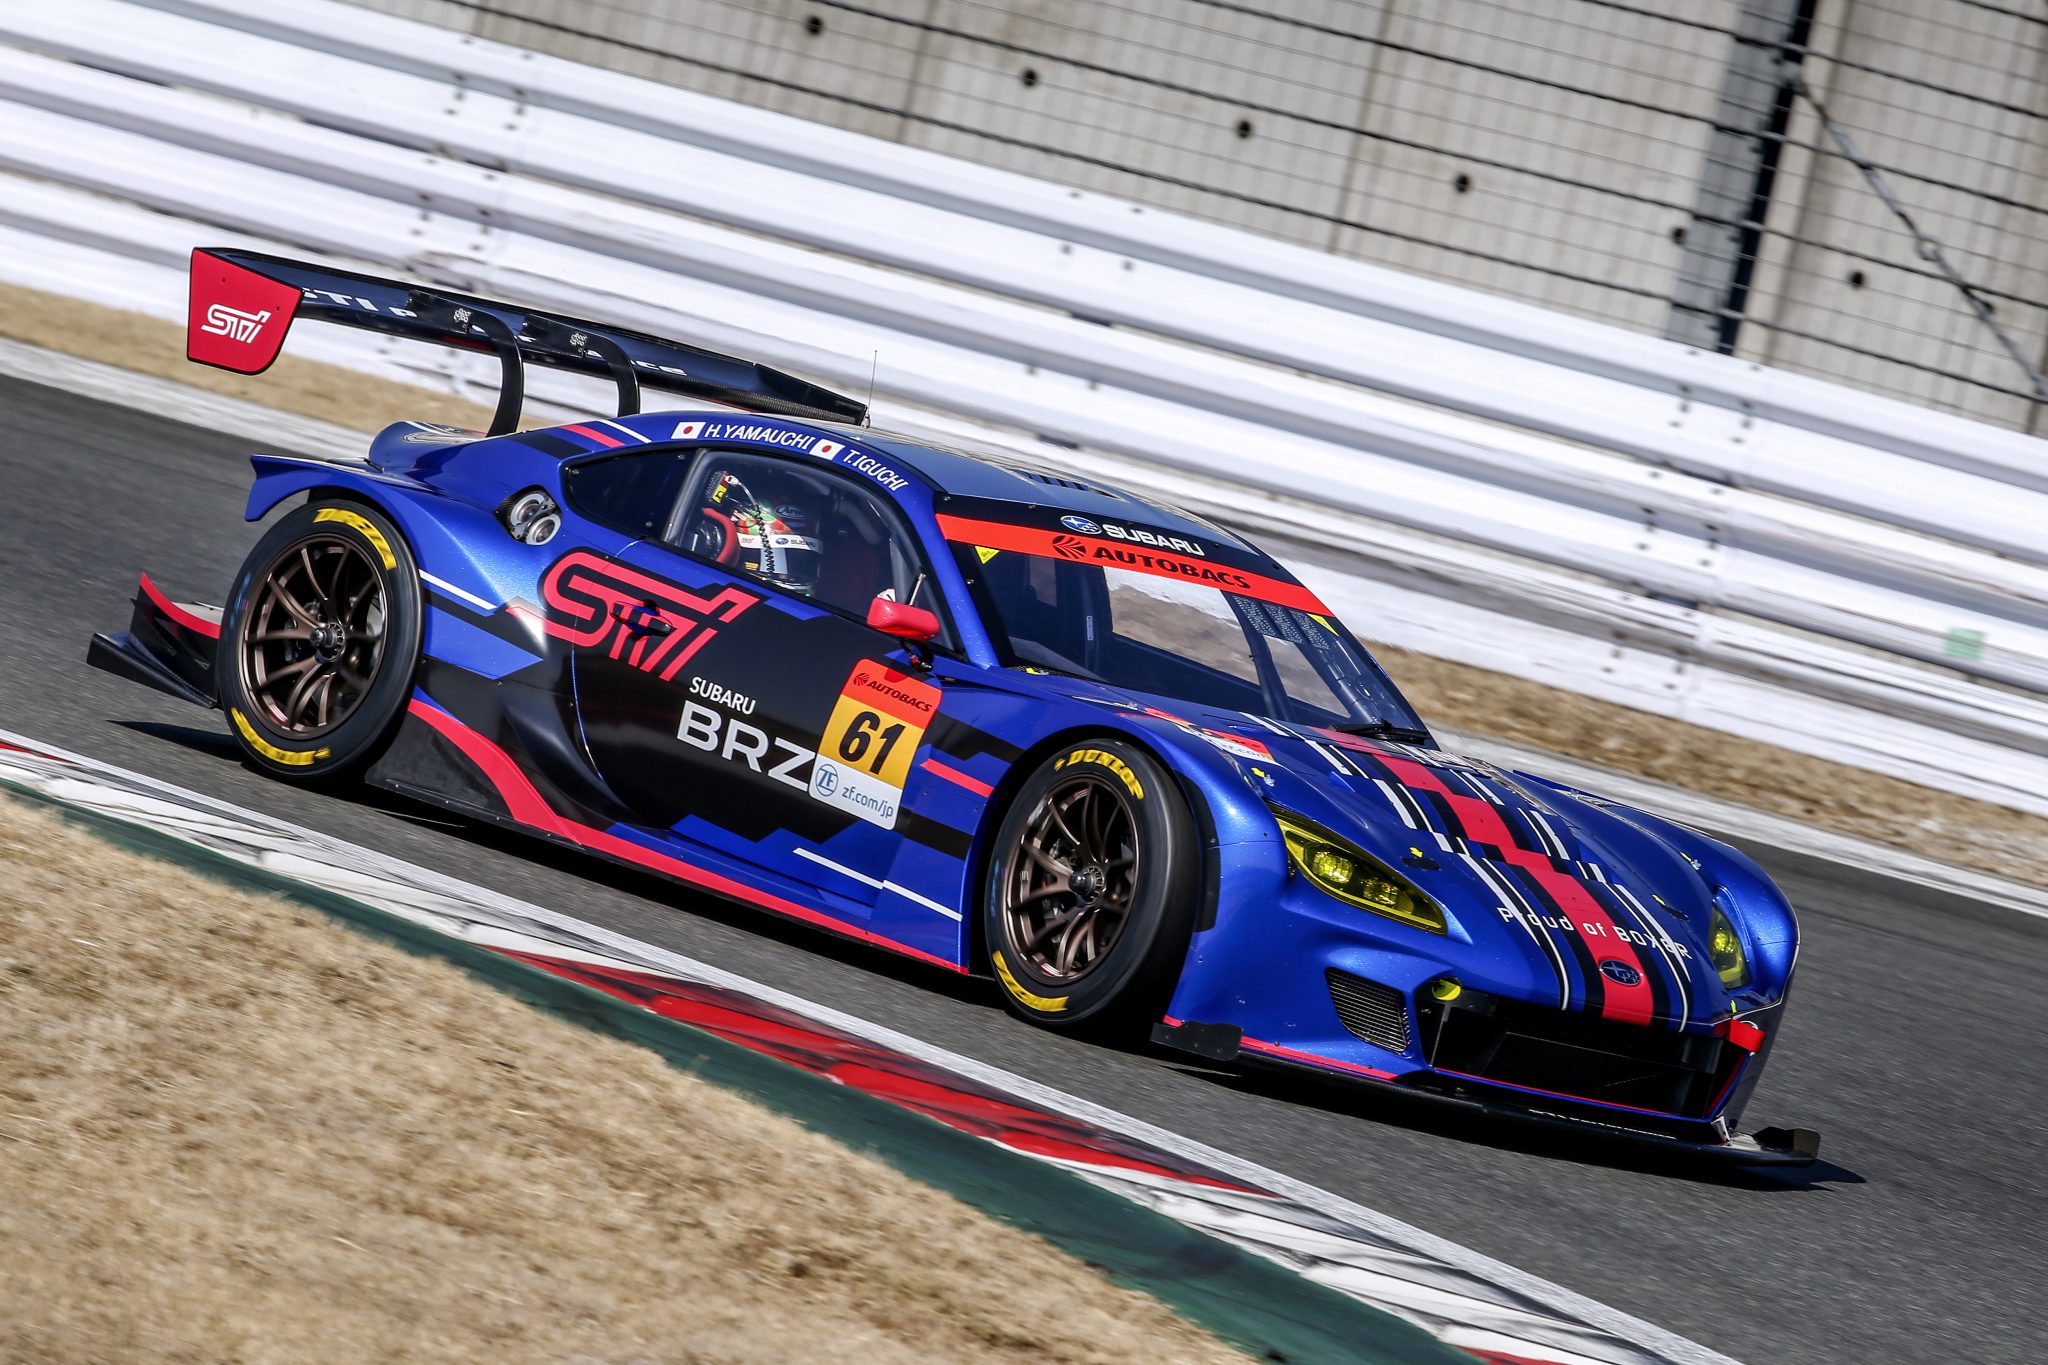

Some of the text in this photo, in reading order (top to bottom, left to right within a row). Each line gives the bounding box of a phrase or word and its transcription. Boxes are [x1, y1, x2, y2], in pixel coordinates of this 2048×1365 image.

[704, 424, 815, 450] H.YAMAUCHI
[842, 449, 909, 492] T.IGUCHI
[1102, 523, 1205, 557] SUBARU
[1094, 546, 1252, 589] AUTOBACS
[689, 677, 756, 715] SUBARU
[867, 680, 933, 713] AUTOBACS
[676, 700, 816, 792] BRZ
[838, 710, 906, 775] 61
[841, 785, 894, 819] zf.com/jp
[1582, 922, 1607, 937] of
[1612, 926, 1693, 960] BOXER
